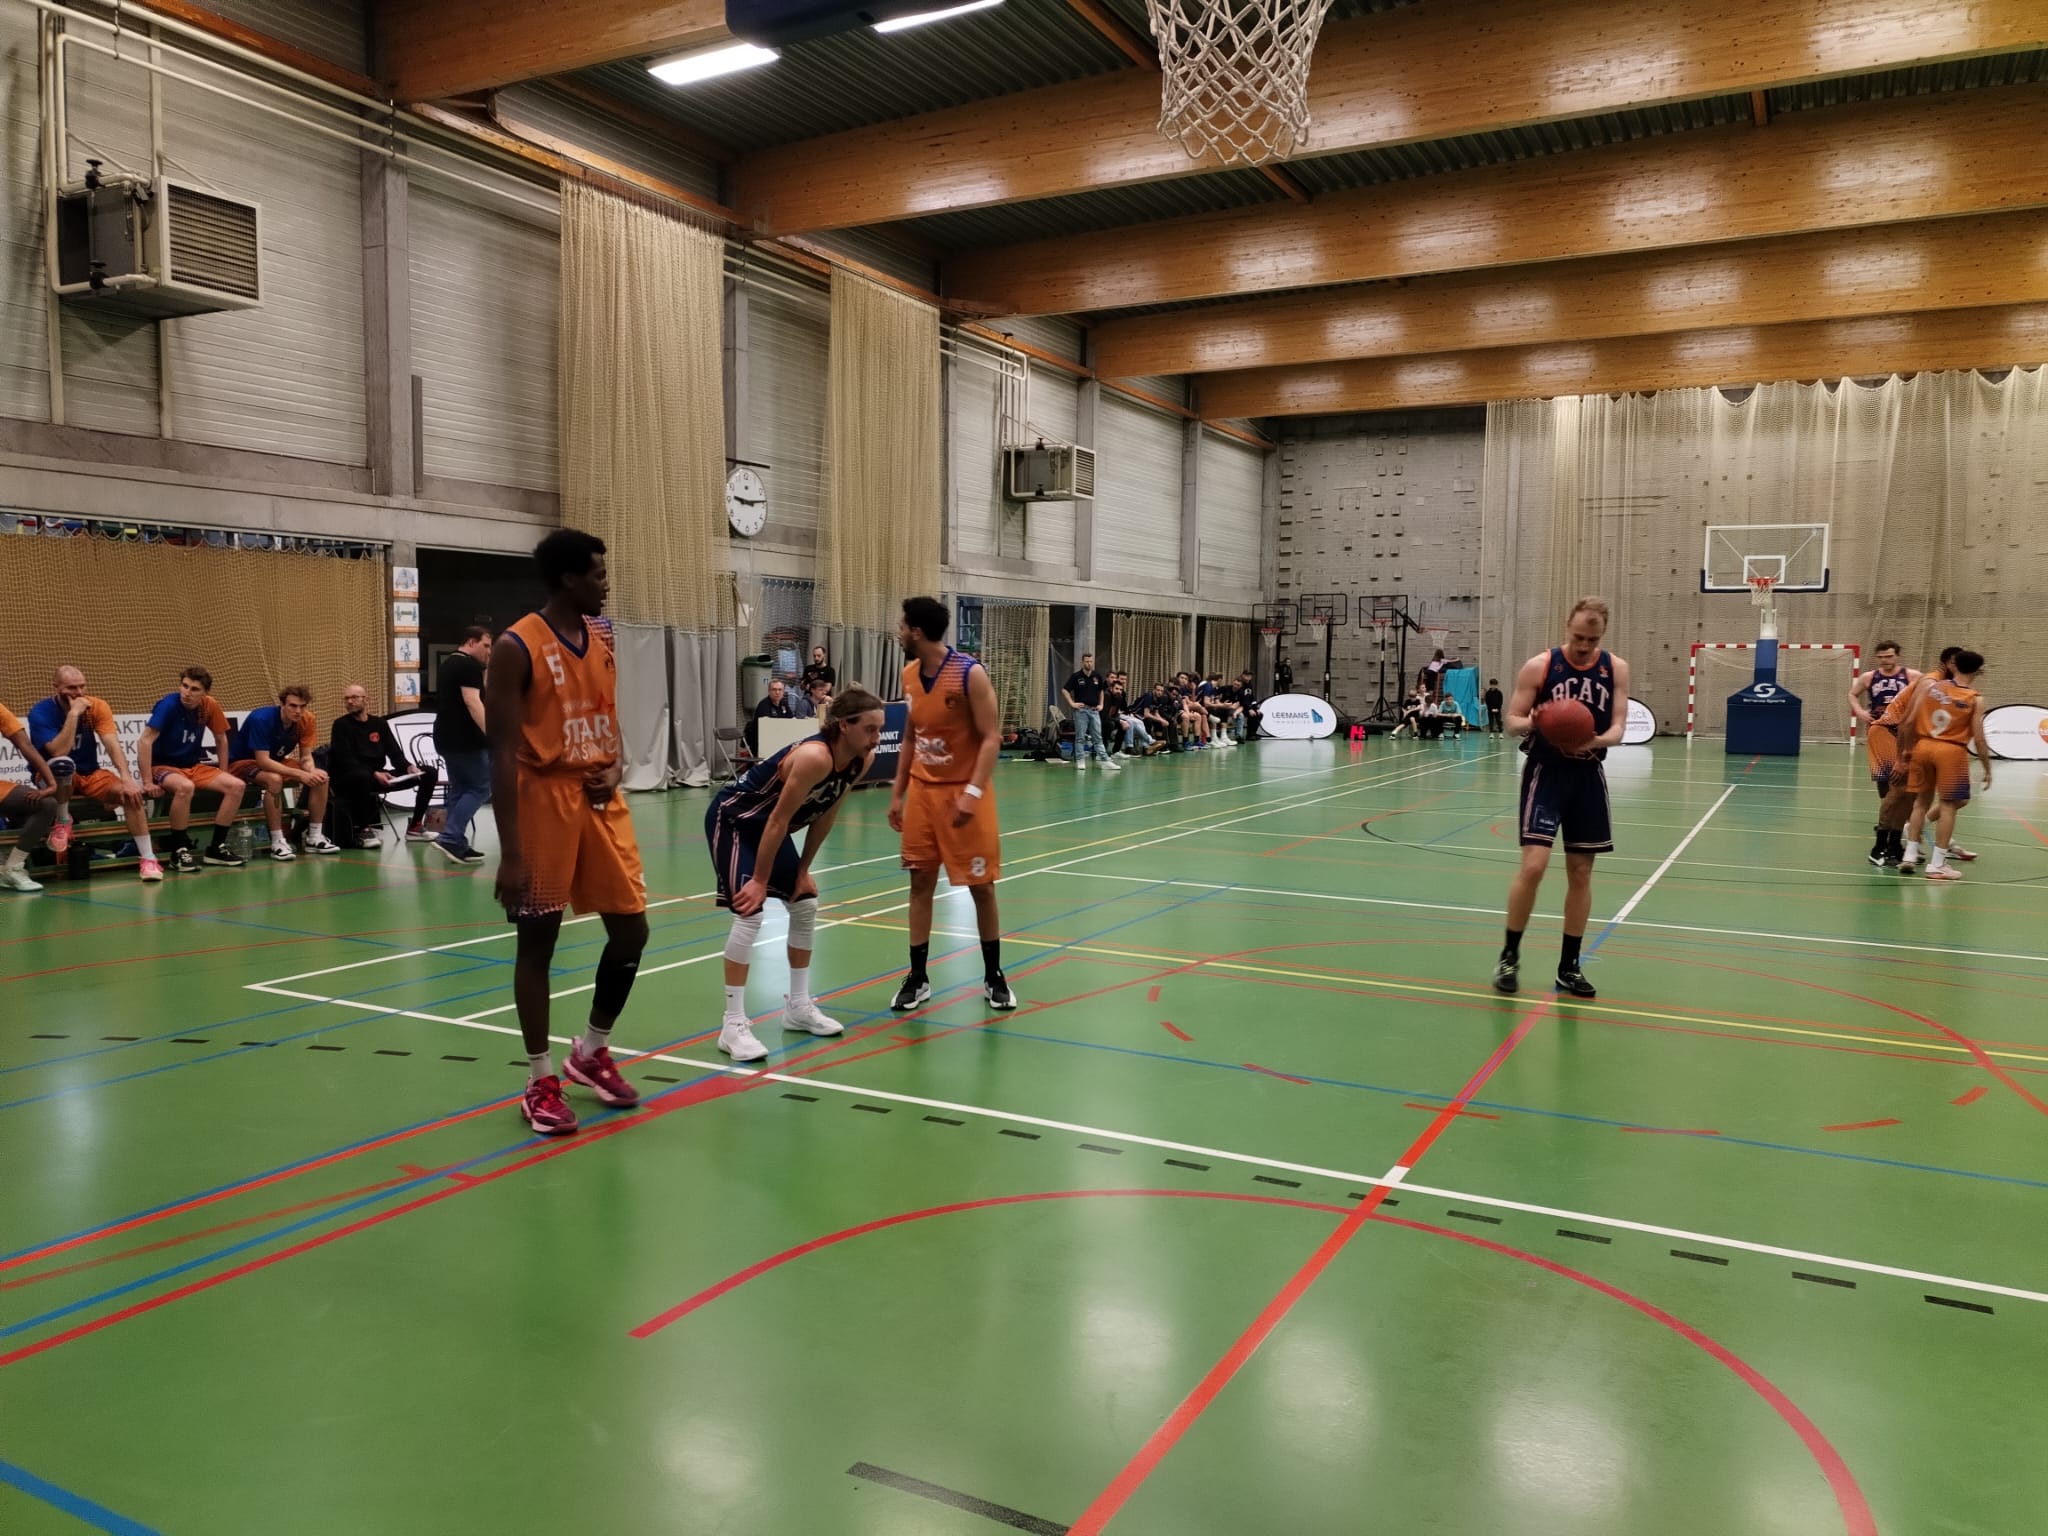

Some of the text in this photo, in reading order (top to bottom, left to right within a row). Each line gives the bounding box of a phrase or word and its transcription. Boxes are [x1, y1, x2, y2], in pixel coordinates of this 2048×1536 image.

[1271, 711, 1310, 719] LEEMANS
[1932, 709, 1953, 738] 9
[182, 729, 197, 744] 14
[562, 714, 613, 747] STAR
[971, 856, 986, 877] 8
